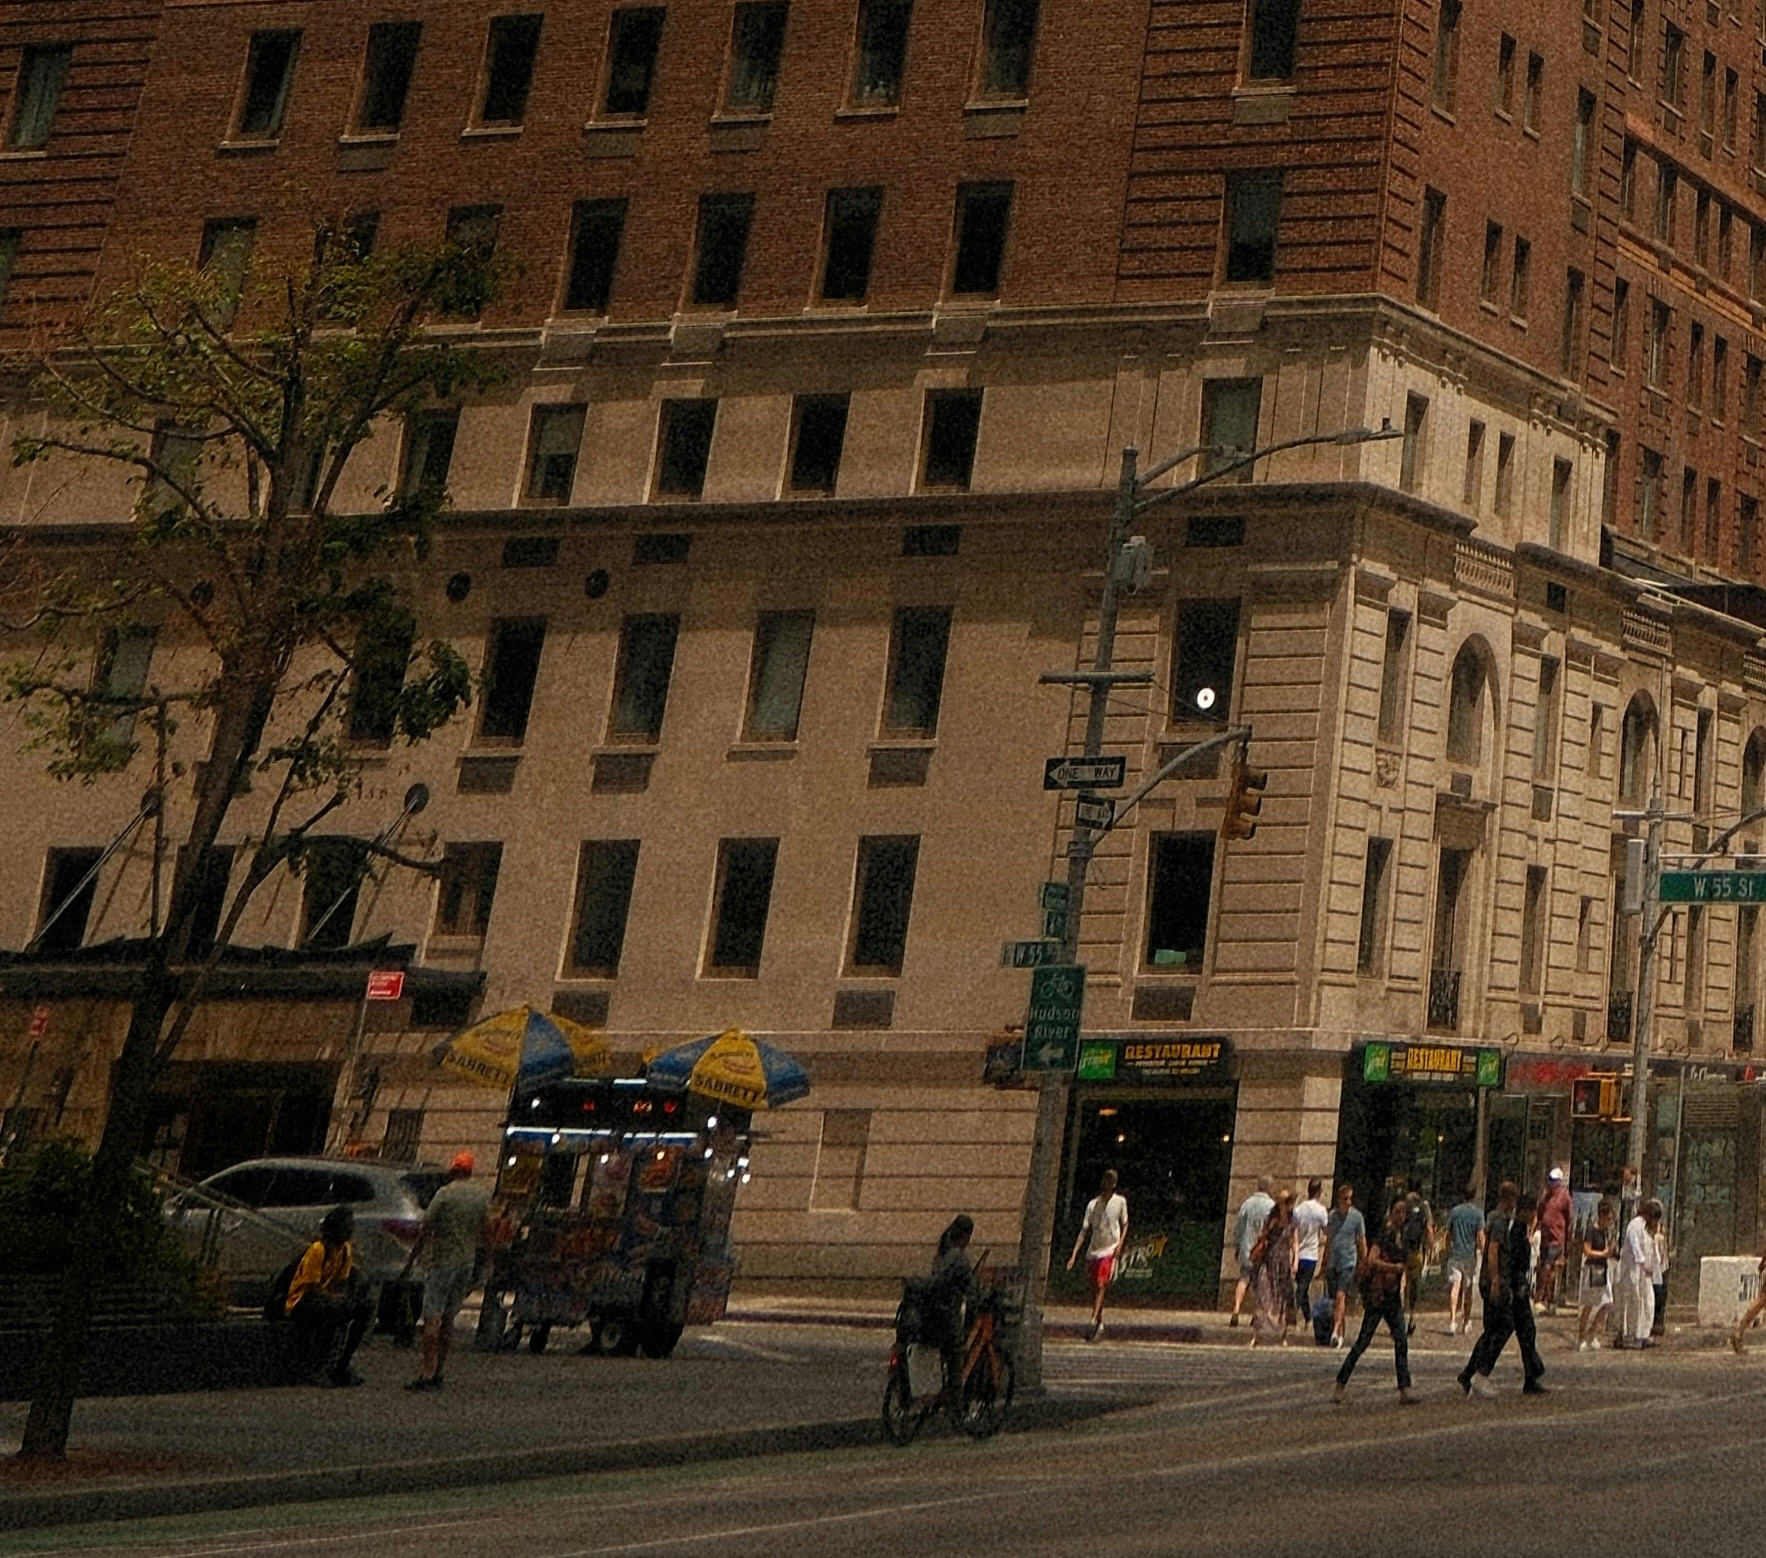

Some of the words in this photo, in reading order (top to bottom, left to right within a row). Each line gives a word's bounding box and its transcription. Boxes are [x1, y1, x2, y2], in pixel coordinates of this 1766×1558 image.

[1057, 767, 1079, 780] ONE
[1094, 765, 1116, 778] WAY
[1693, 877, 1707, 898] W
[1712, 877, 1732, 898] 55
[1737, 876, 1754, 898] St
[1030, 1005, 1078, 1020] Hudson
[1033, 1025, 1069, 1039] River
[1124, 1042, 1221, 1060] RESTAURANT
[1407, 1046, 1462, 1072] RESTAURANT
[450, 1053, 511, 1084] SABRETT
[697, 1077, 763, 1102] SABRETT
